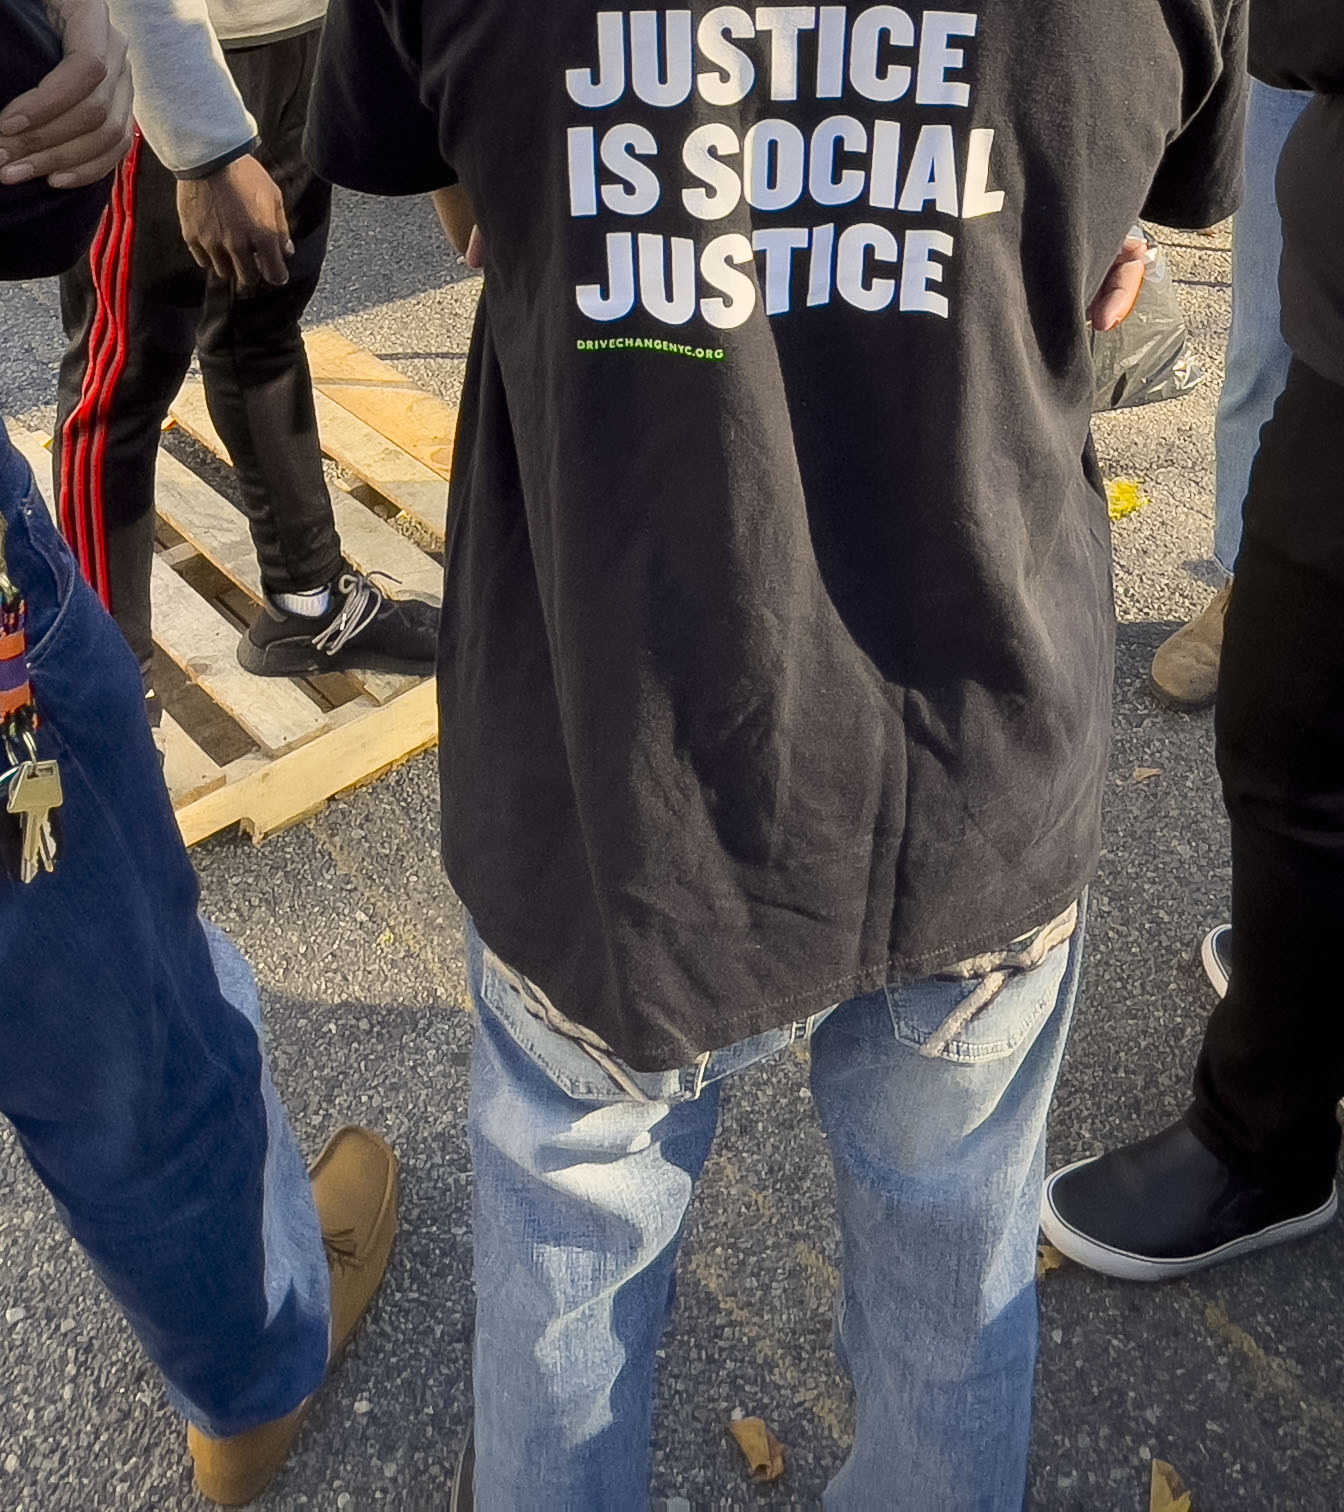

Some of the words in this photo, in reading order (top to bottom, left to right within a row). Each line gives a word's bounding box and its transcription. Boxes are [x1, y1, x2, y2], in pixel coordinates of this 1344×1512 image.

[565, 5, 978, 109] JUSTICE
[566, 123, 661, 217] IS
[681, 115, 1006, 221] SOCIAL
[575, 222, 954, 330] JUSTICE
[576, 337, 726, 360] DRIVECHANGENYC.ORG
